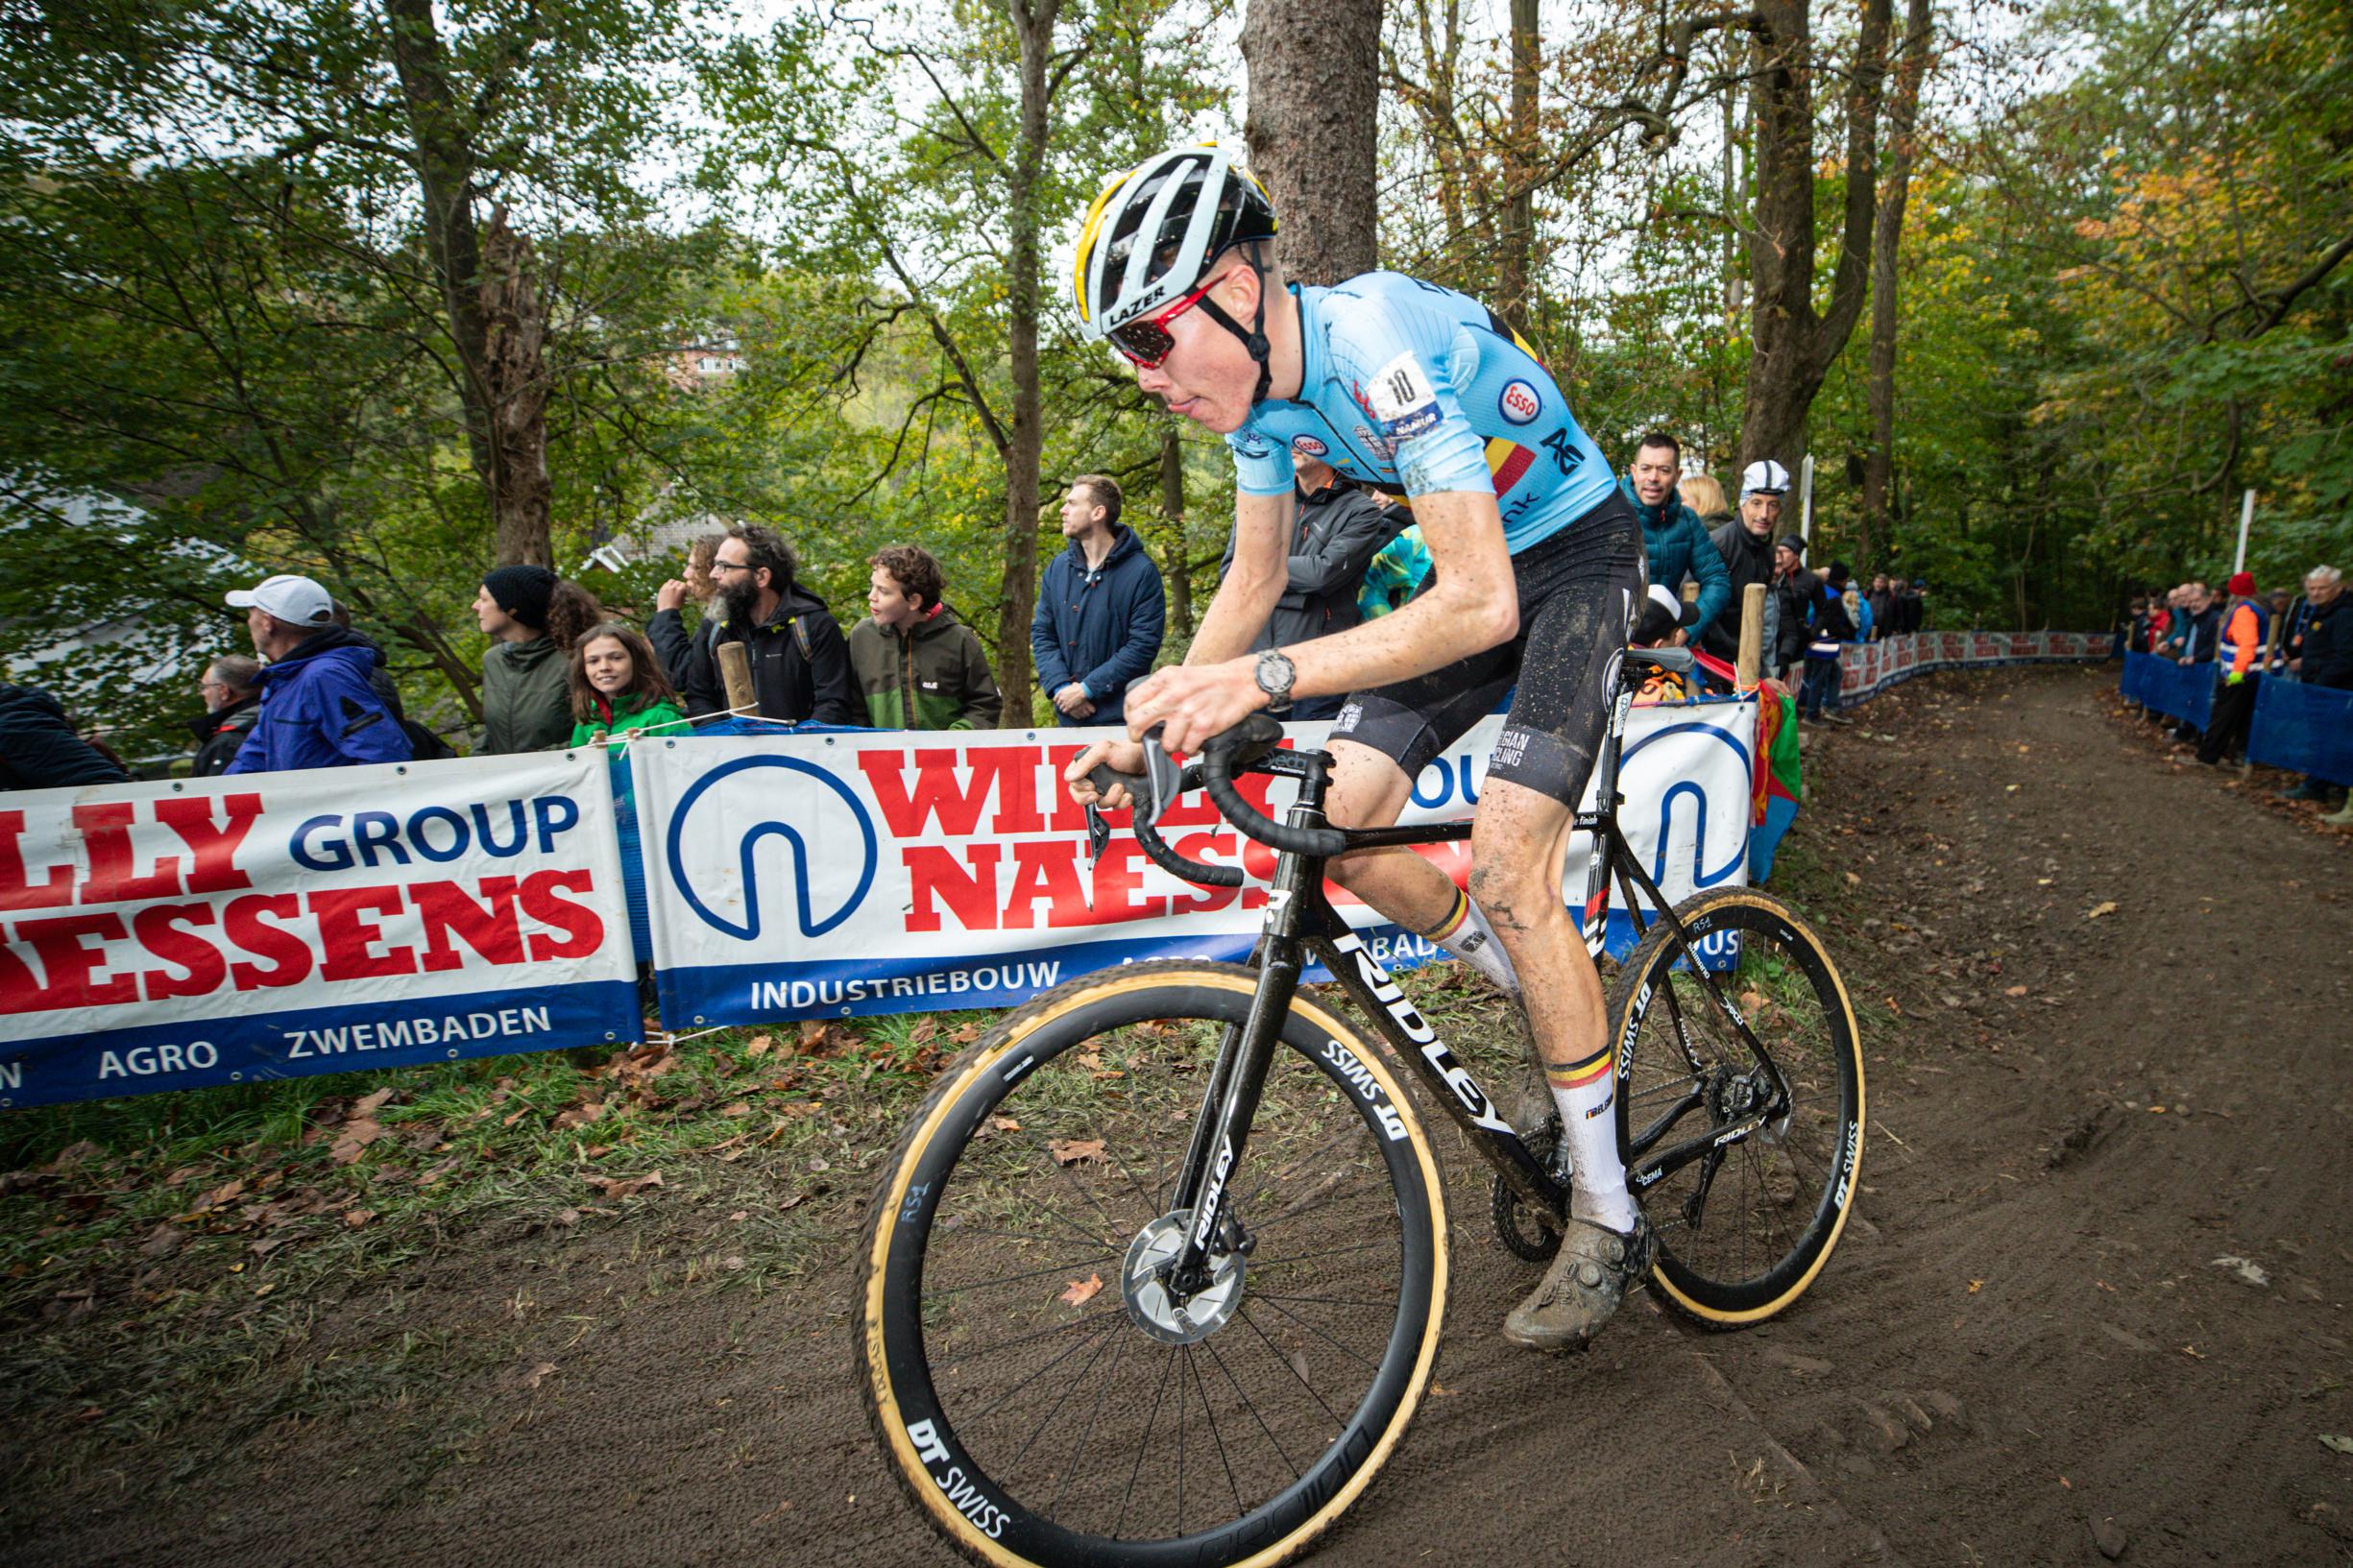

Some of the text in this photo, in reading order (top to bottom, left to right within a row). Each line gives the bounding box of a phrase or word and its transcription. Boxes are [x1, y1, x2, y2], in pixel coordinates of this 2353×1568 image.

[1109, 285, 1166, 327] LAZER
[1387, 369, 1416, 406] 10
[1395, 413, 1437, 436] NAMUR
[290, 795, 579, 871] GROUP
[751, 961, 1060, 1010] INDUSTRIEBOUW
[1686, 941, 1710, 979] SHIMANO
[98, 1041, 218, 1079] AGRO
[283, 1006, 551, 1059] ZWEMBADEN
[1333, 933, 1517, 1135] RIDLEY
[1618, 981, 1652, 1081] DT SWISS
[1678, 1017, 1701, 1068] RIDLEY
[1321, 1039, 1409, 1142] DT SWISS
[1713, 1115, 1767, 1148] RIDLEY
[1195, 1134, 1234, 1250] RIDLEY
[1642, 1166, 1662, 1187] CEMA
[1833, 1120, 1859, 1211] DT SWISS
[907, 1417, 1011, 1538] DT SWISS
